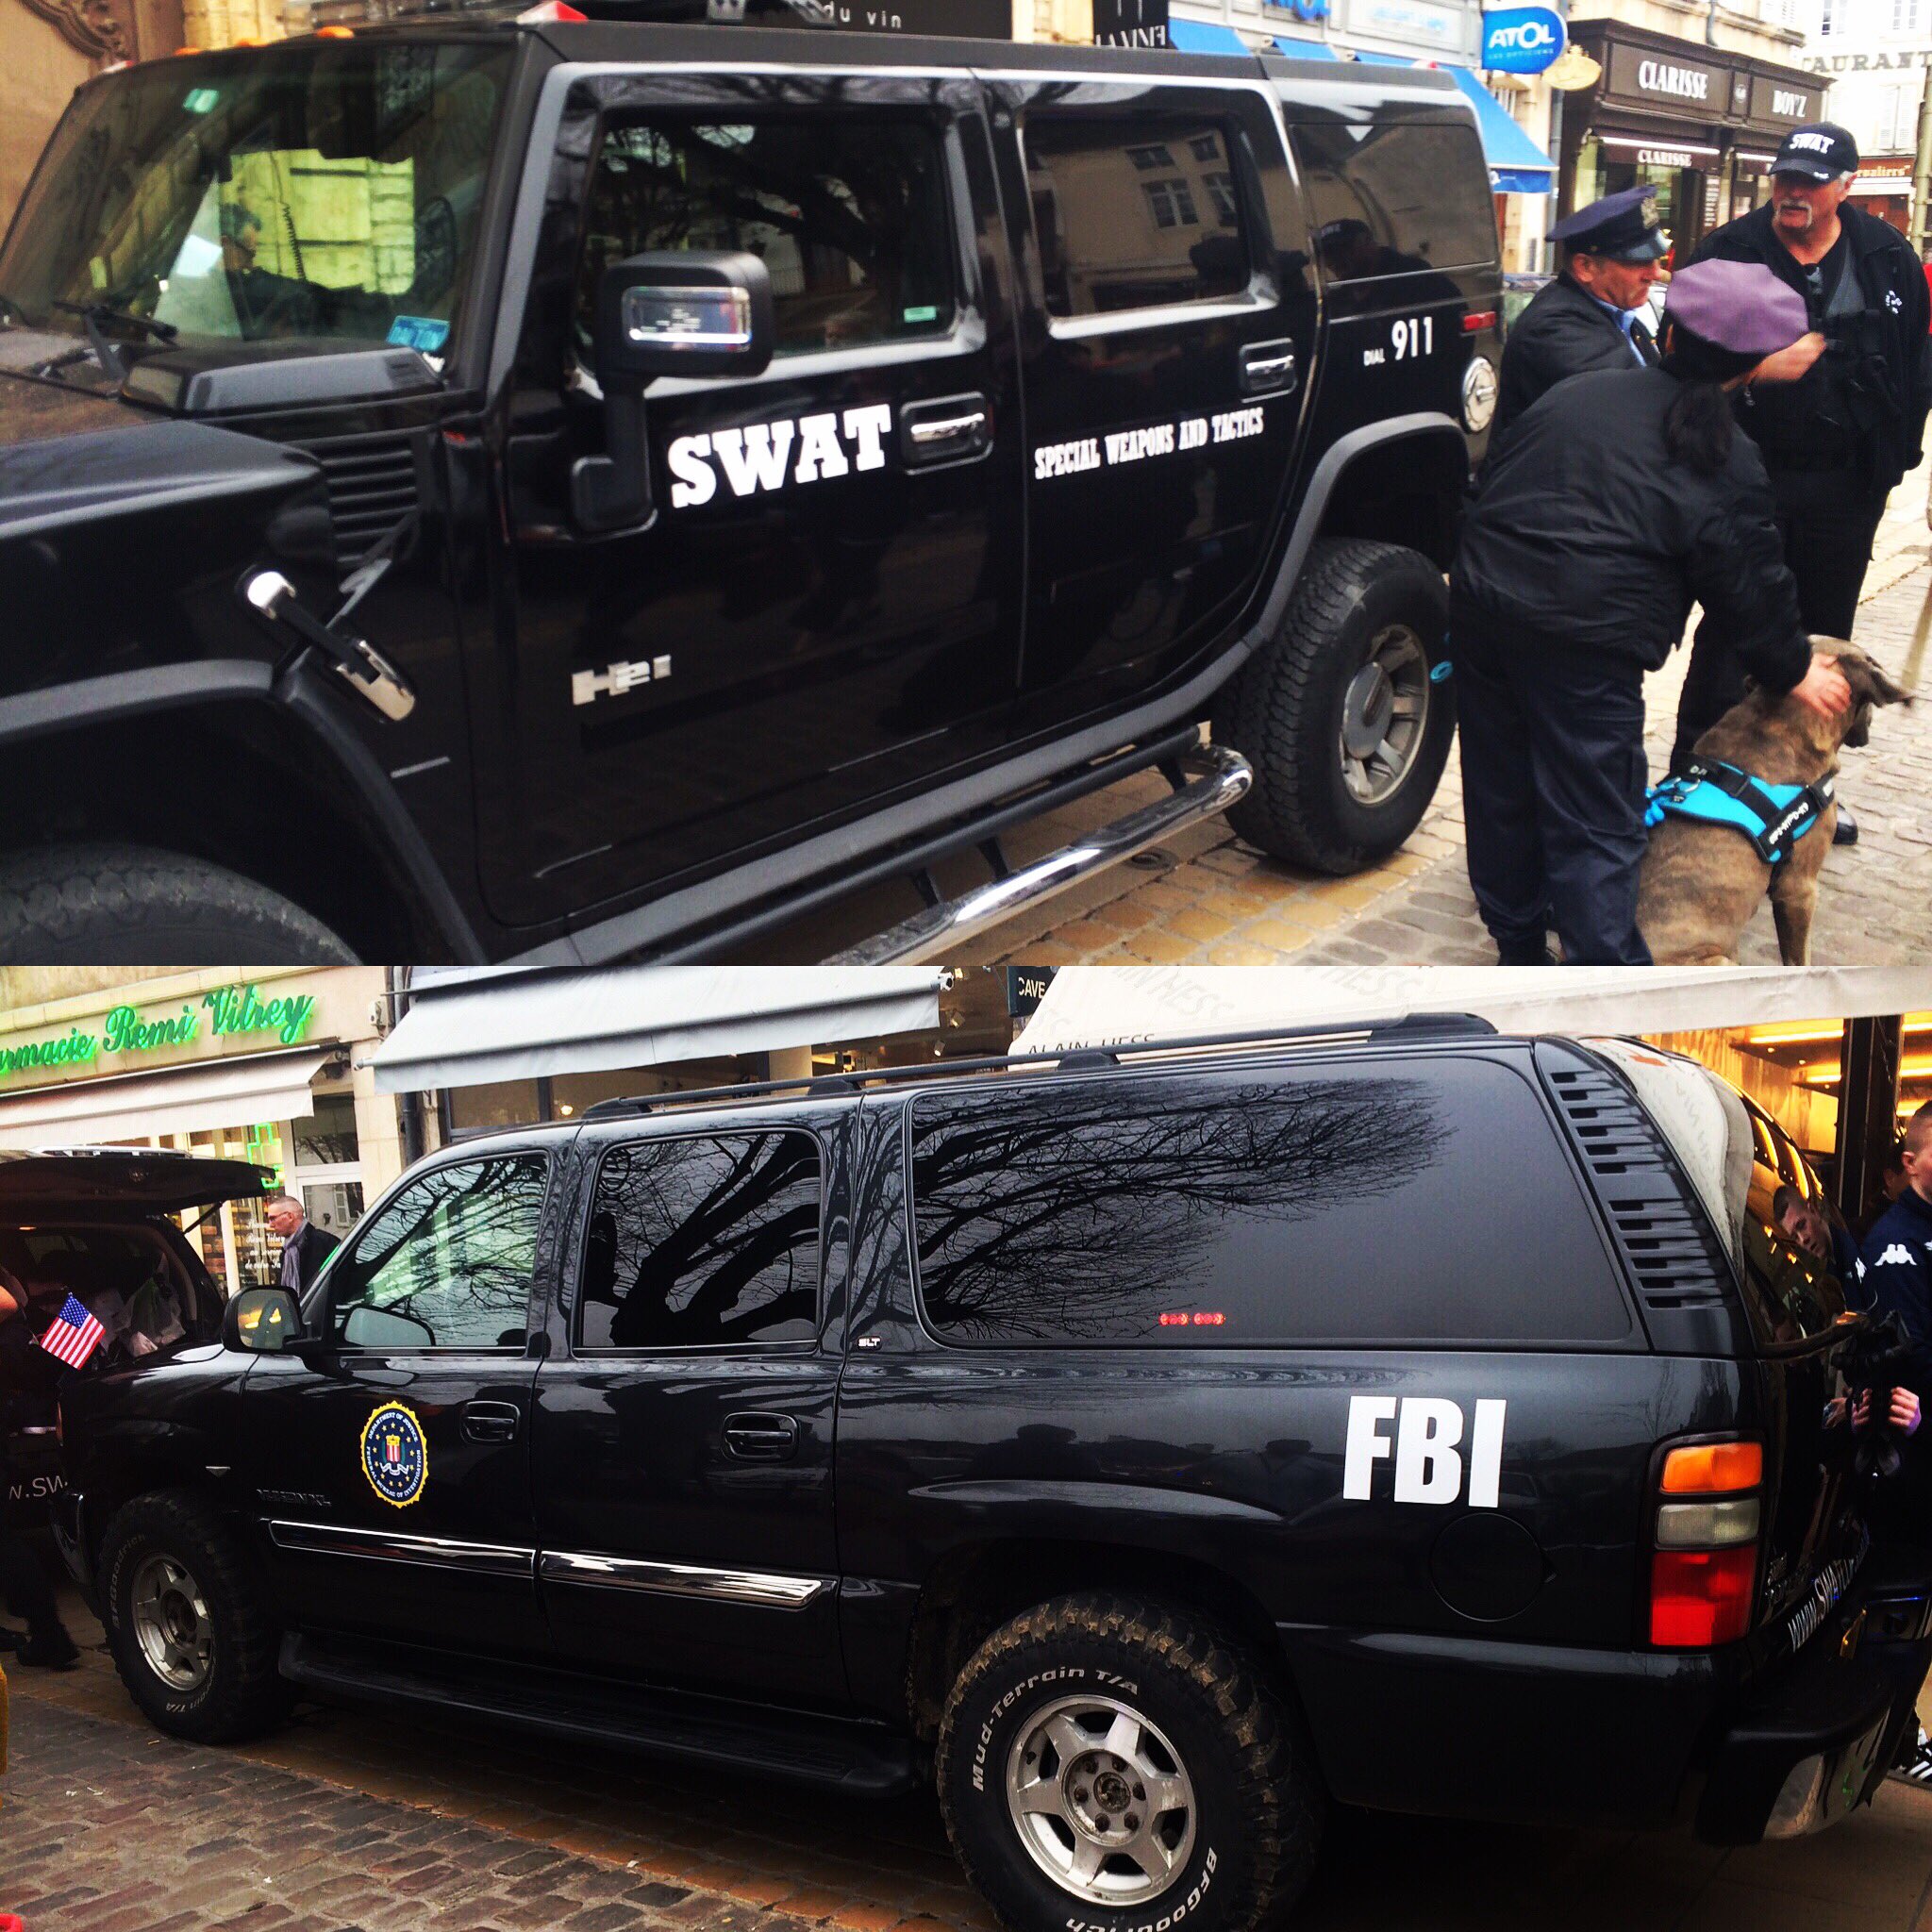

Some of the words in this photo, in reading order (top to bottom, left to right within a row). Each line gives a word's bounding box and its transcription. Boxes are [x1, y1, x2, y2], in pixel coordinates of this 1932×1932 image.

[823, 1, 851, 23] du
[867, 10, 902, 28] vin
[1488, 21, 1556, 49] ATOL
[1639, 60, 1709, 100] CLARISSE
[1638, 148, 1693, 168] CLARISSE
[1789, 132, 1836, 155] SWAT
[1391, 316, 1433, 360] 911
[668, 404, 891, 509] SWAT
[1035, 438, 1101, 479] SPECIAL
[1105, 425, 1174, 465] WEAPONS
[1179, 419, 1208, 450] AND
[1211, 407, 1265, 443] TACTICS
[1018, 976, 1046, 999] CAVE
[368, 1411, 395, 1440] DEPARTMENT
[402, 1417, 419, 1442] JUSTICE
[1343, 1395, 1507, 1508] FBI
[973, 1666, 1085, 1792] Mud-Terrain
[1095, 1669, 1139, 1696] T/A
